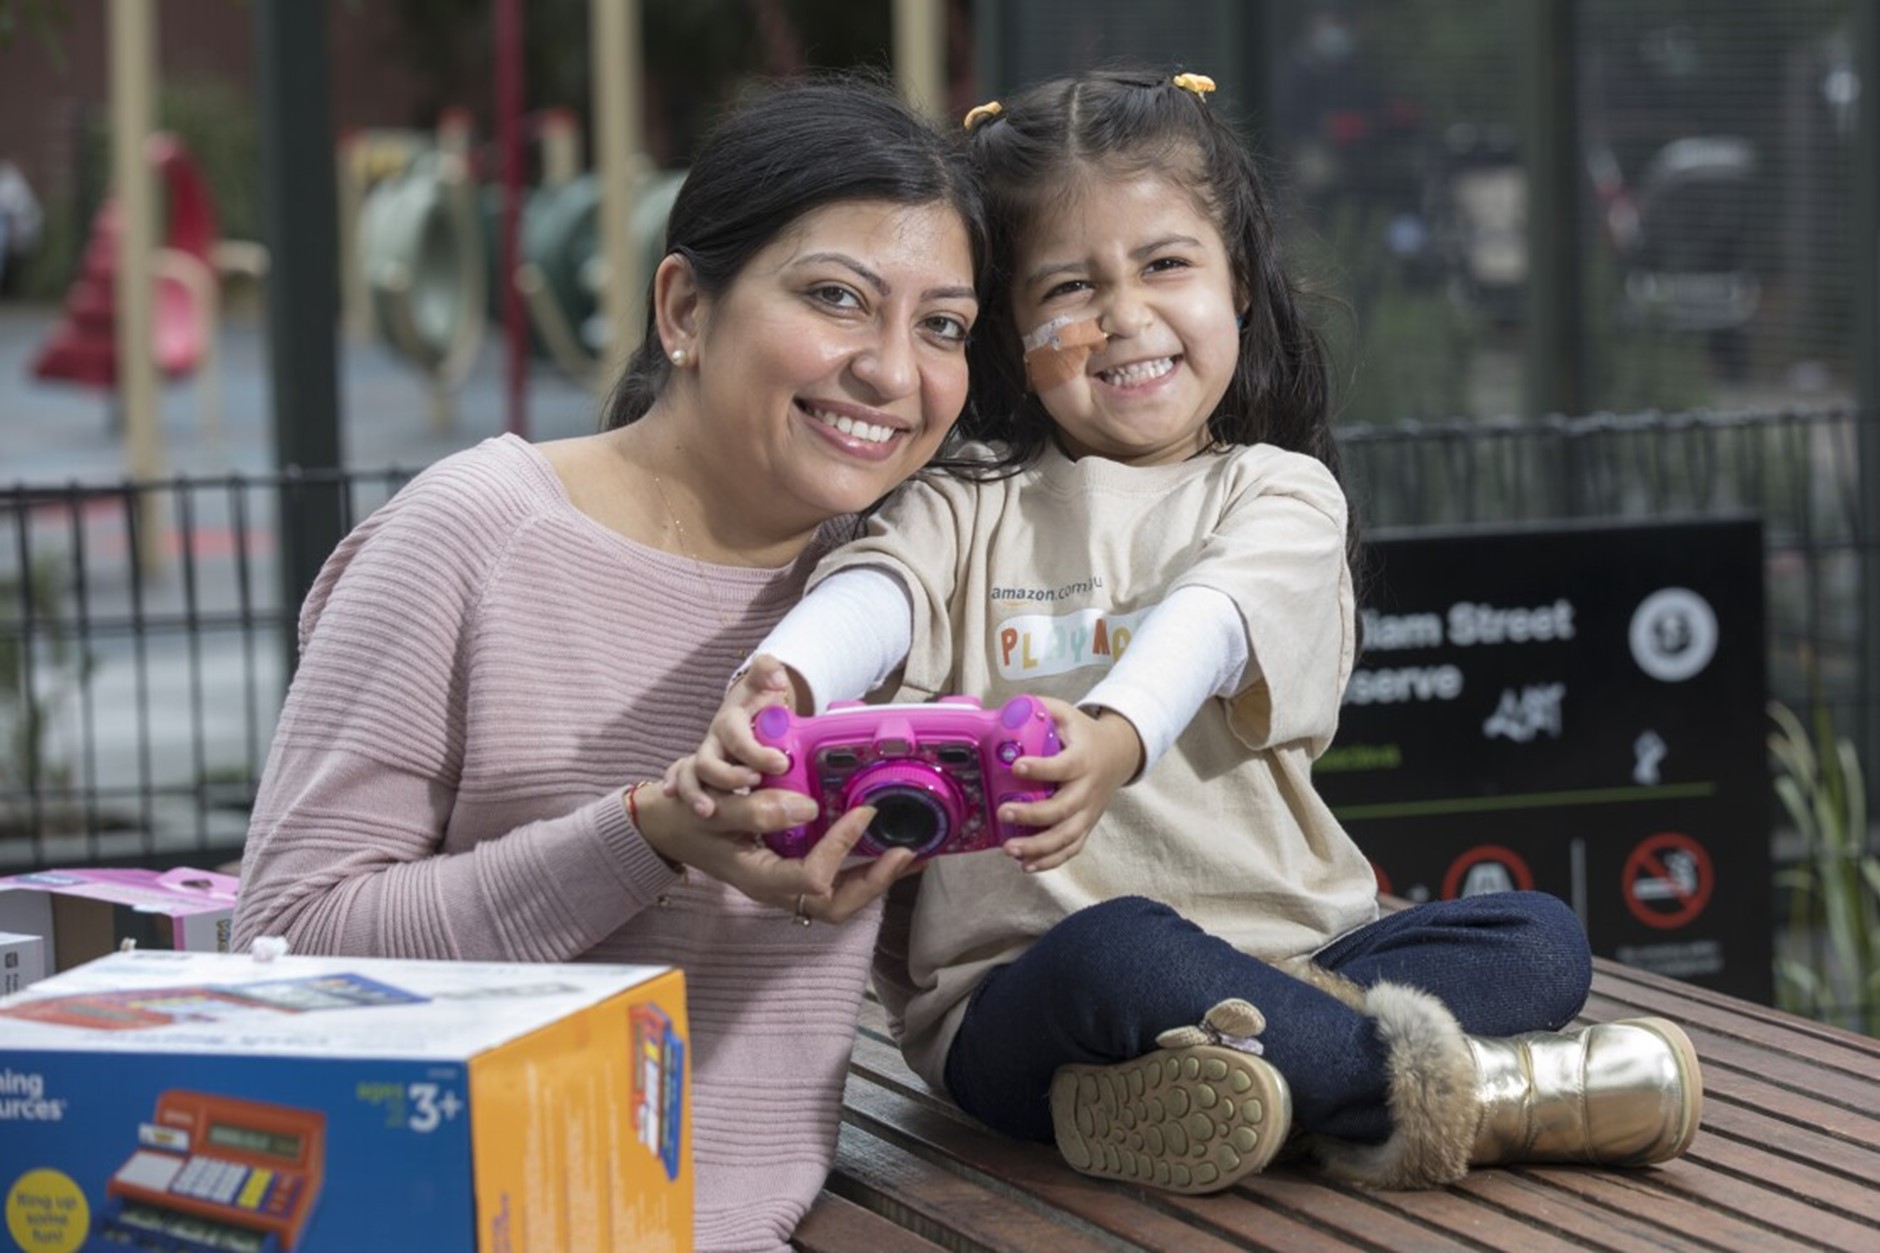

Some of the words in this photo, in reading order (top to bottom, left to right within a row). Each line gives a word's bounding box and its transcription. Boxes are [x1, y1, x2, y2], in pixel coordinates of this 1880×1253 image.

[1446, 598, 1576, 646] Street
[1342, 663, 1464, 706] serve
[408, 1081, 462, 1133] 3+
